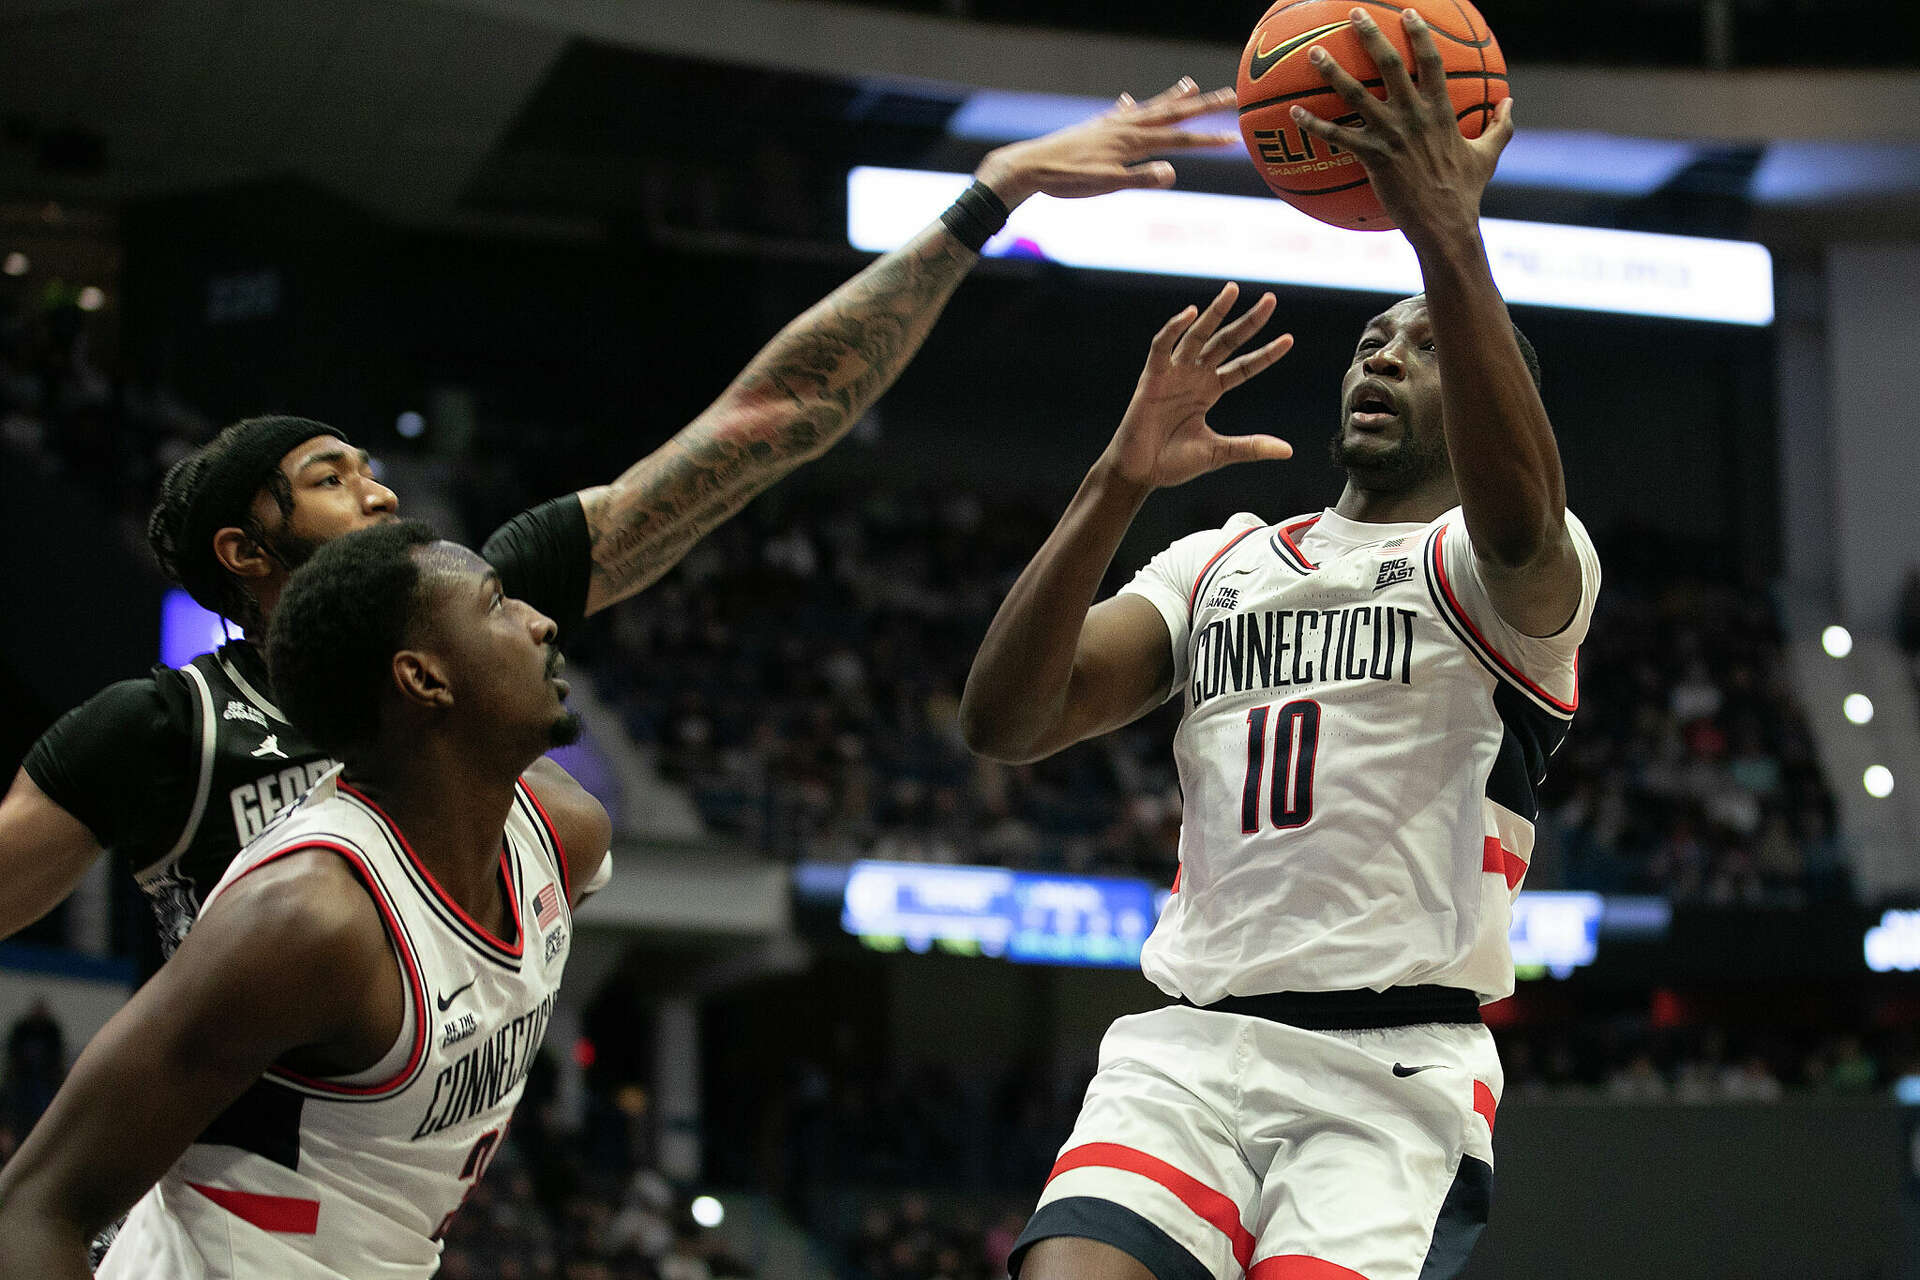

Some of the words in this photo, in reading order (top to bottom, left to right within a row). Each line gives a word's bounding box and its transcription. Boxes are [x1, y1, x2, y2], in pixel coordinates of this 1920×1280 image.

[1253, 111, 1367, 164] ELI
[1267, 155, 1359, 176] CHAMPIONS
[1379, 557, 1408, 573] BIG
[1376, 566, 1415, 584] EAST
[1218, 587, 1240, 599] THE
[1206, 597, 1238, 610] ANGE
[1192, 606, 1417, 708] CONNECTICUT
[1241, 698, 1321, 834] 10
